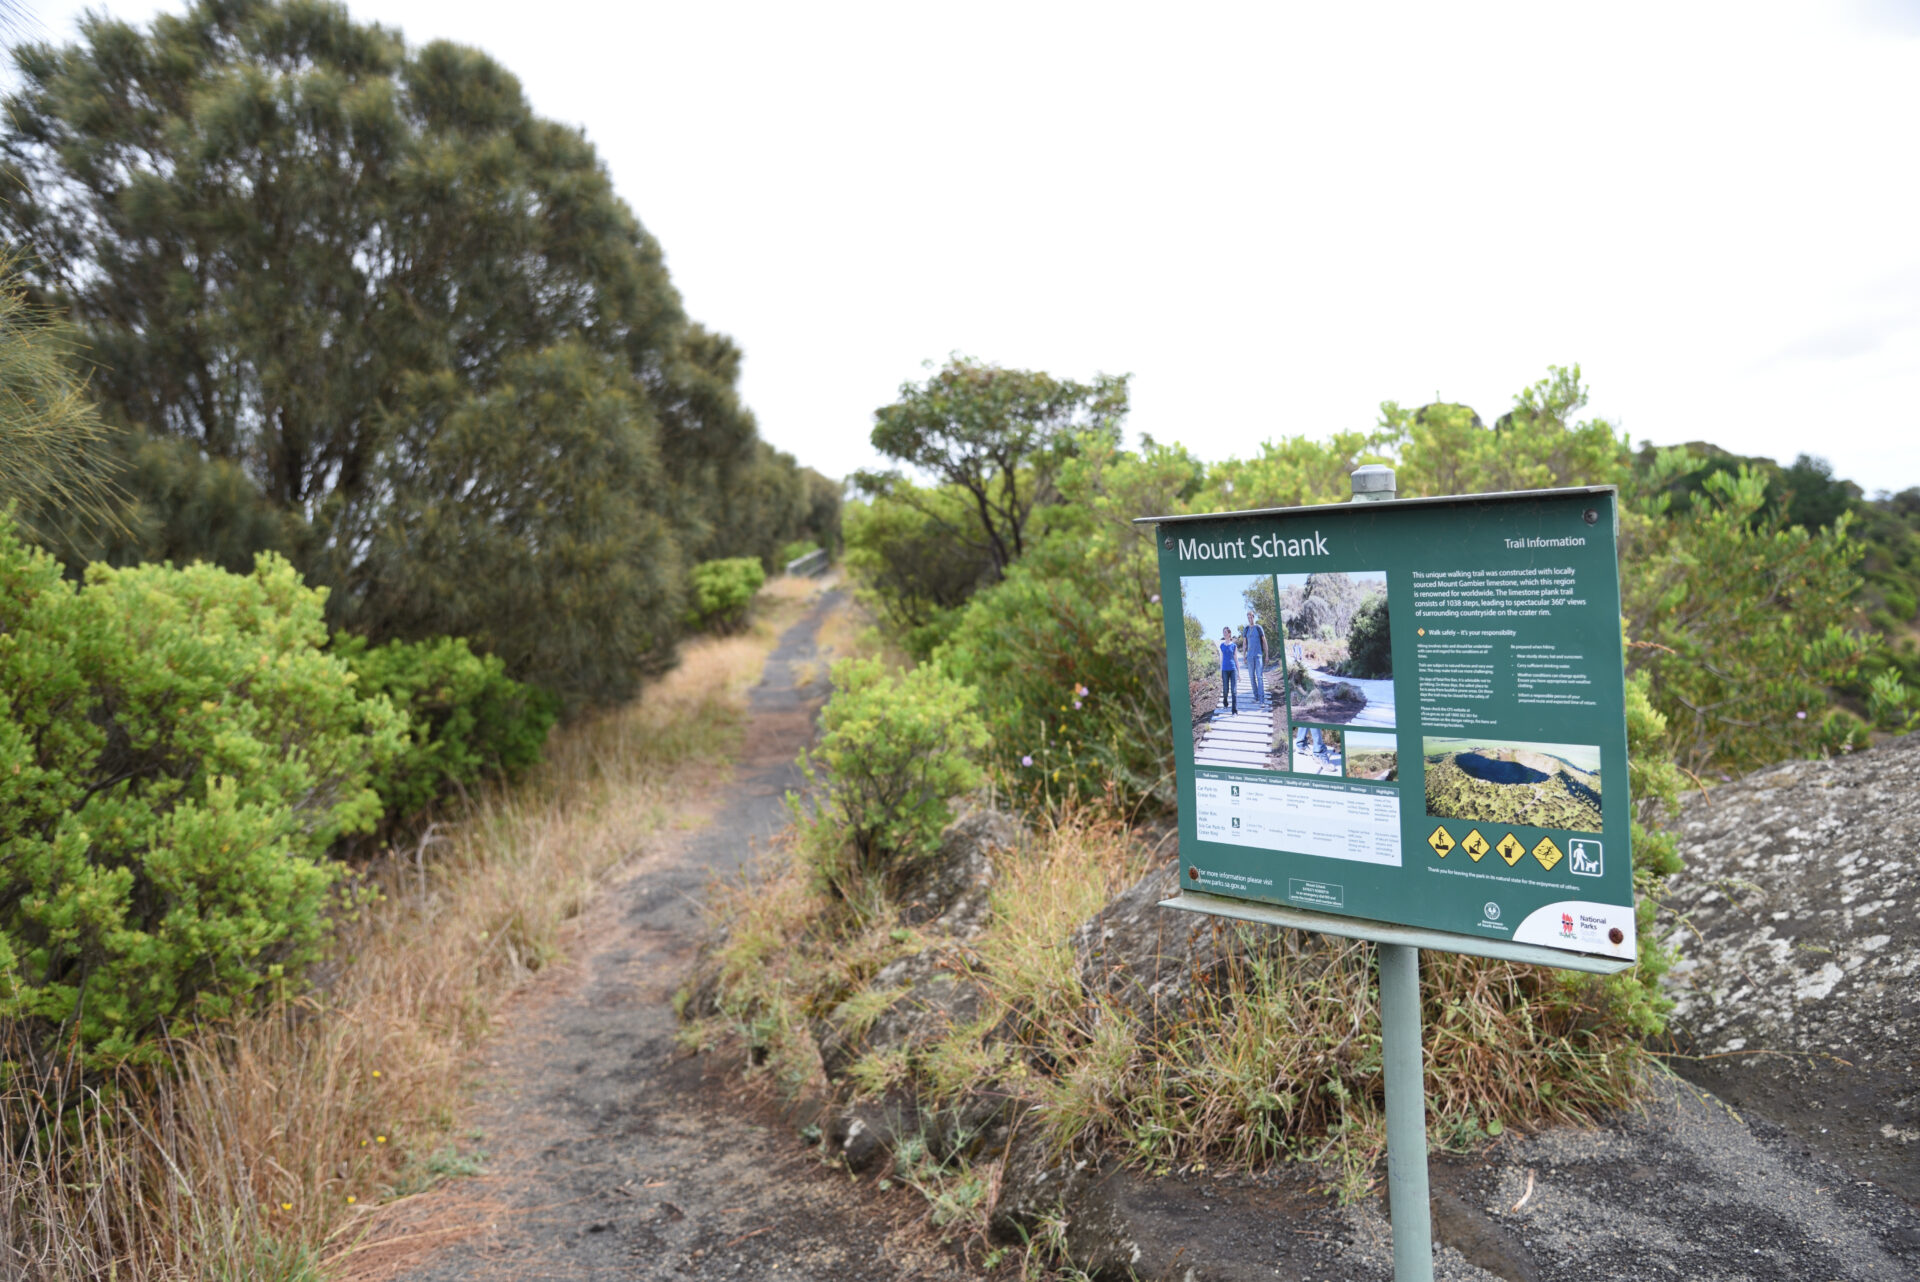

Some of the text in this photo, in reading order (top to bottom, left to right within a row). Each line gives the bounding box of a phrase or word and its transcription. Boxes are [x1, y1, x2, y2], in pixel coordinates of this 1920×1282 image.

[1178, 531, 1329, 560] Mount Schank
[1504, 537, 1585, 548] Trail Information
[1425, 571, 1446, 580] unique
[1447, 570, 1471, 579] walking
[1553, 568, 1575, 577] locally
[1486, 578, 1518, 588] limestone,
[1553, 577, 1575, 586] region
[1540, 588, 1559, 597] plank
[1462, 599, 1479, 608] steps,
[1480, 599, 1504, 608] leading
[1513, 598, 1550, 607] spectacular
[1422, 609, 1459, 618] surrounding
[1460, 609, 1496, 617] countryside
[1219, 872, 1246, 881] information
[1246, 876, 1262, 885] please
[1580, 915, 1606, 924] National
